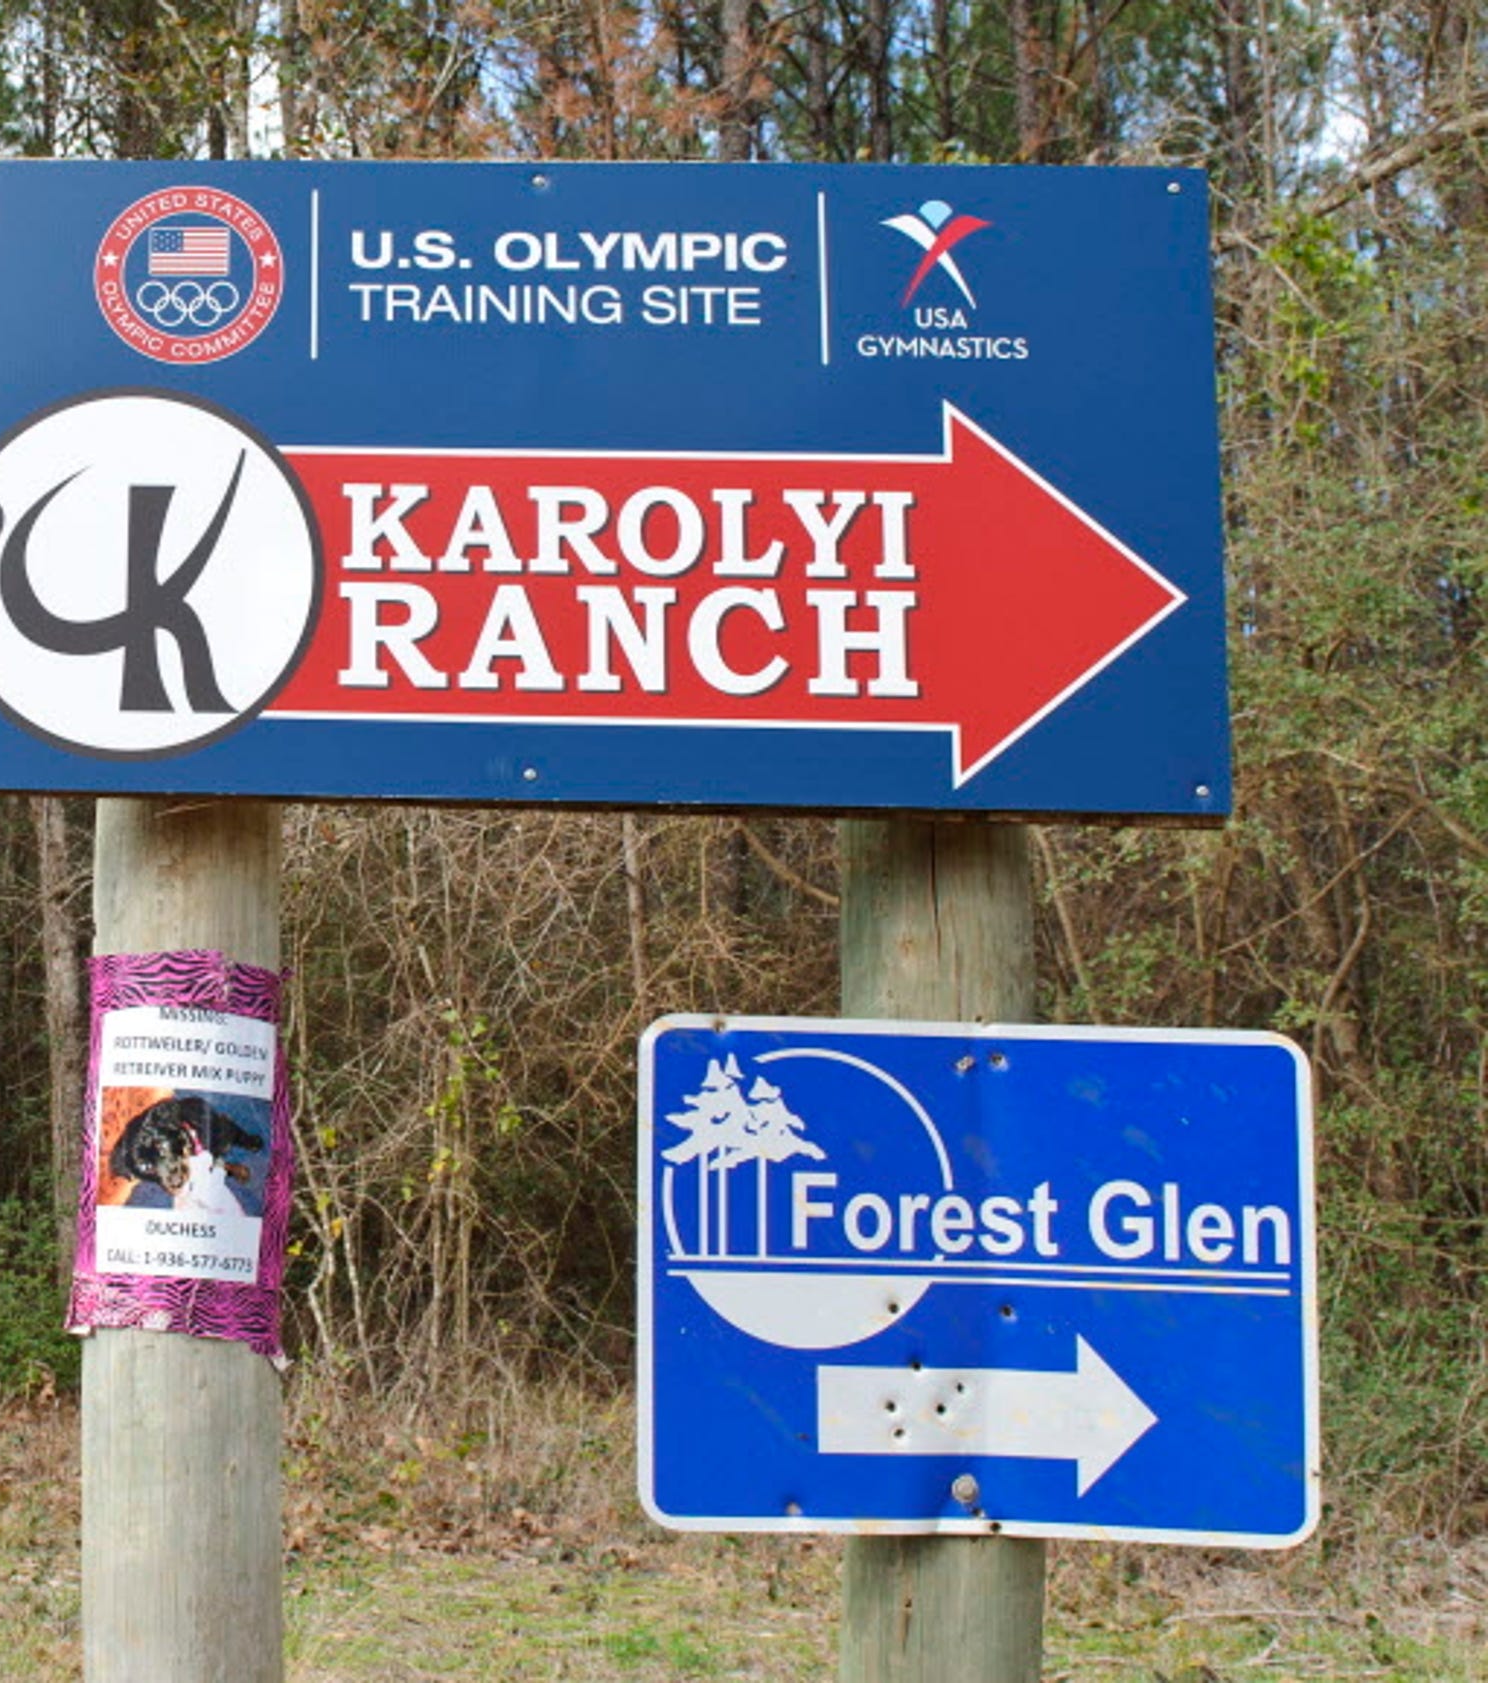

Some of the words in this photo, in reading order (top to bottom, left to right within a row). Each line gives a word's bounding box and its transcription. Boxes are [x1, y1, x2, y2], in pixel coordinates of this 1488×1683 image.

[116, 193, 187, 240] UNITED
[194, 194, 263, 241] STATES
[350, 230, 472, 269] U.S.
[493, 231, 788, 272] OLYMPIC
[102, 281, 164, 350] OLYMPIC
[170, 282, 275, 357] COMMITTEE
[349, 283, 622, 324] TRAINING
[641, 286, 762, 325] SITE
[914, 307, 968, 329] USA
[856, 335, 1029, 359] GYMNASTICS
[340, 483, 917, 580] KAROLYI
[337, 582, 920, 698] RANCH
[215, 1042, 268, 1061] GOLDEN
[191, 1064, 223, 1082] MIX
[226, 1068, 267, 1087] PUPPY
[145, 1219, 217, 1239] DUCHESS
[791, 1172, 1058, 1257] Forest
[1088, 1179, 1292, 1265] Glen
